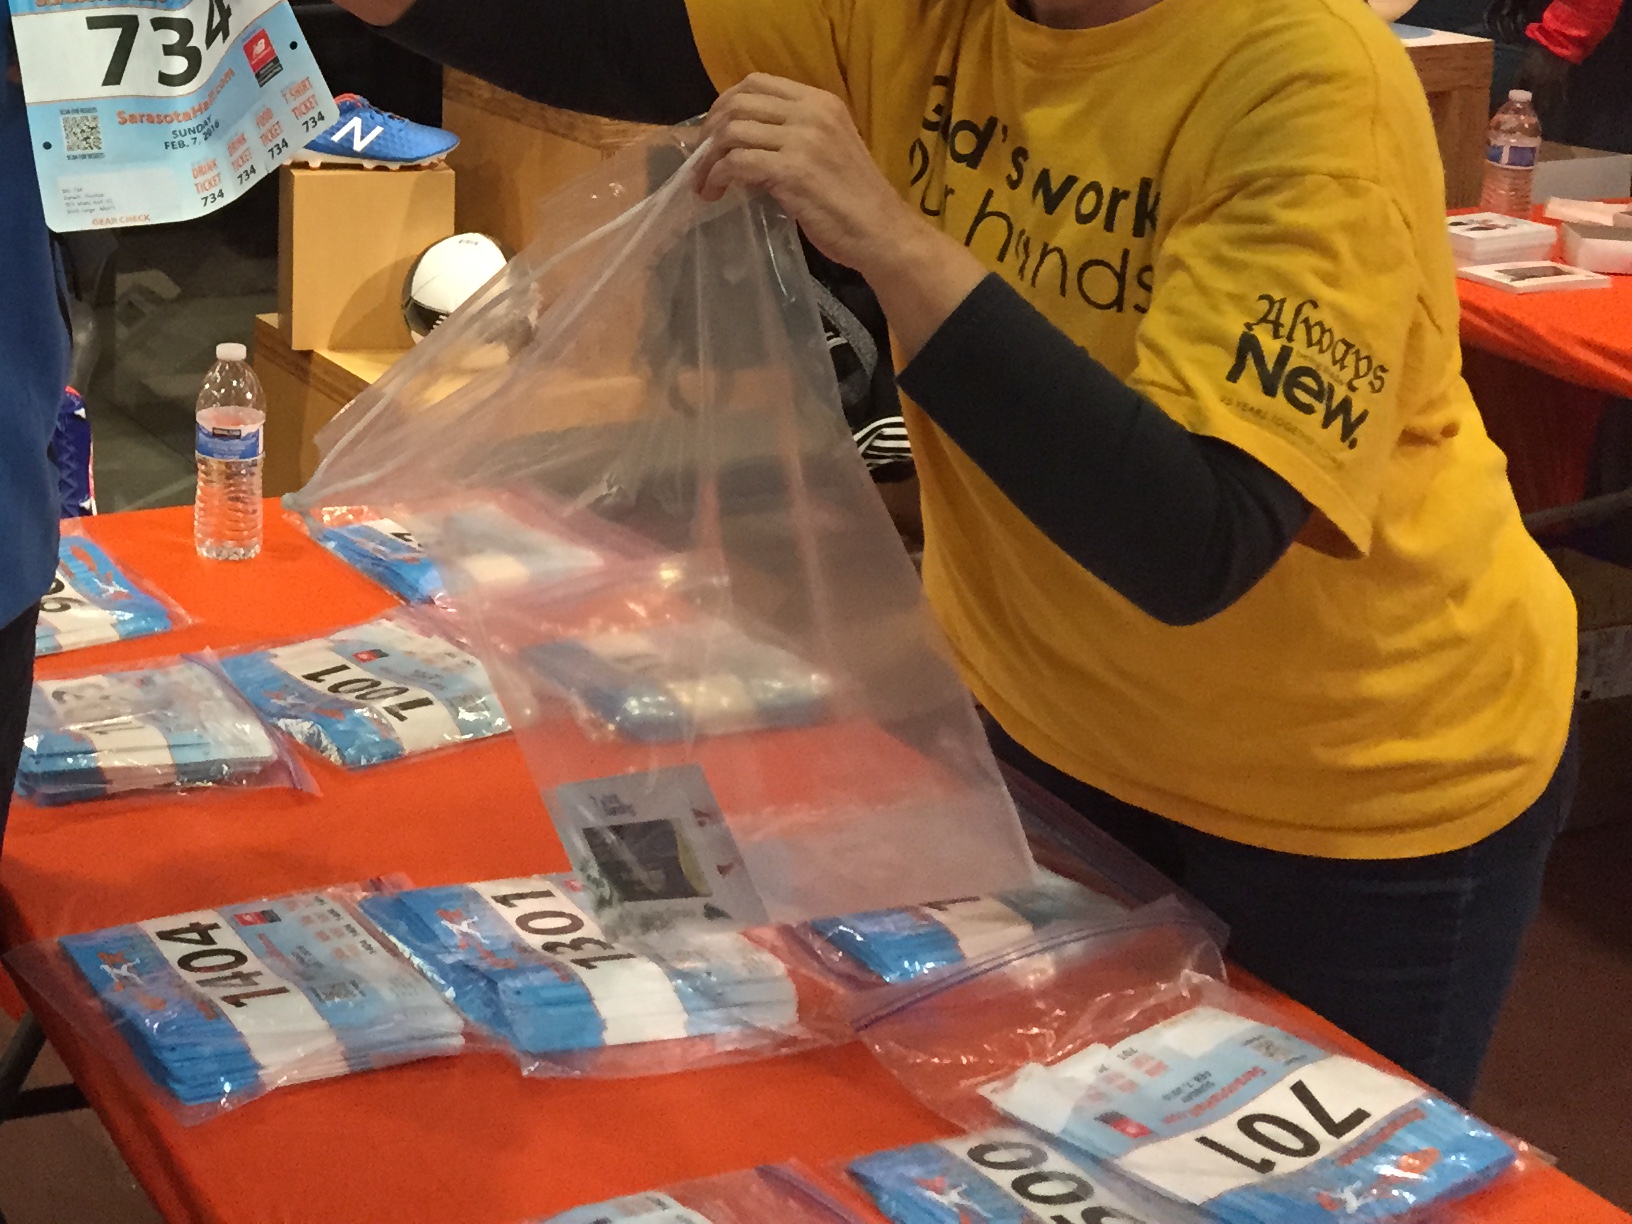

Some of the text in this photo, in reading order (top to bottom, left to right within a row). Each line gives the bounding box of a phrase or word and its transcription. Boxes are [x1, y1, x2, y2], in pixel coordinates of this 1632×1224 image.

[171, 115, 212, 139] SUNDAY
[301, 110, 325, 133] 734
[164, 140, 190, 150] FEB.
[267, 137, 289, 160] 734
[237, 164, 257, 185] 734
[201, 188, 225, 207] 734
[1243, 293, 1390, 394] Always
[1225, 330, 1370, 450] New.
[301, 663, 435, 723] 1001
[491, 888, 638, 971] 1301
[155, 920, 291, 1009] 1404
[1193, 1079, 1372, 1175] 701
